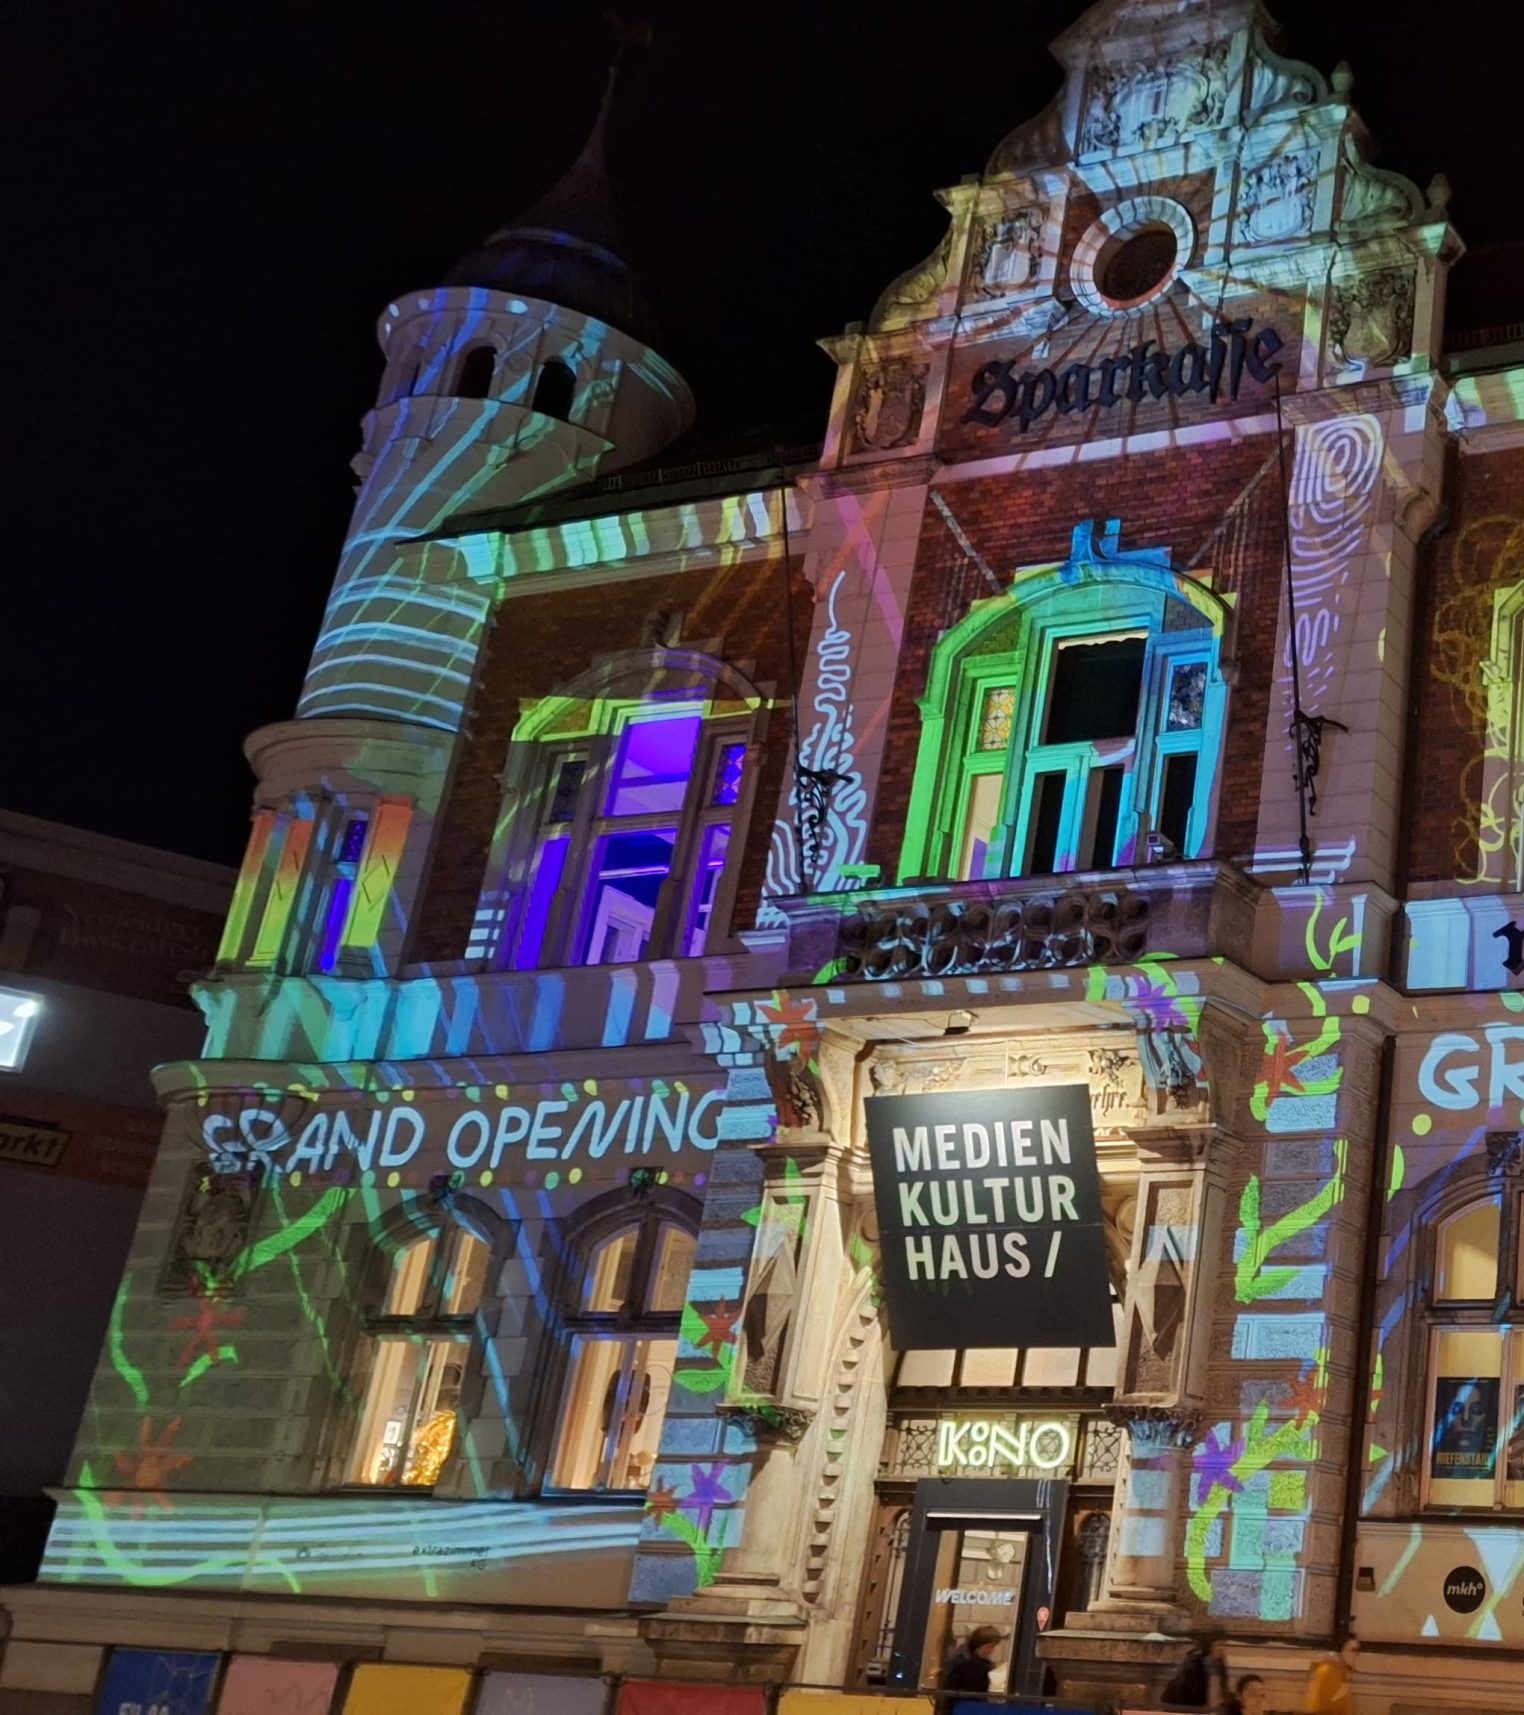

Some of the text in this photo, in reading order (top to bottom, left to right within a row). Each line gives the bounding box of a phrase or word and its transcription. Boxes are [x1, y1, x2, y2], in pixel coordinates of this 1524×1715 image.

[893, 1118, 1071, 1172] MEDIEN
[899, 1174, 1079, 1227] KULTUR
[905, 1231, 1032, 1281] HAUS
[935, 1588, 1014, 1605] WELCOME
